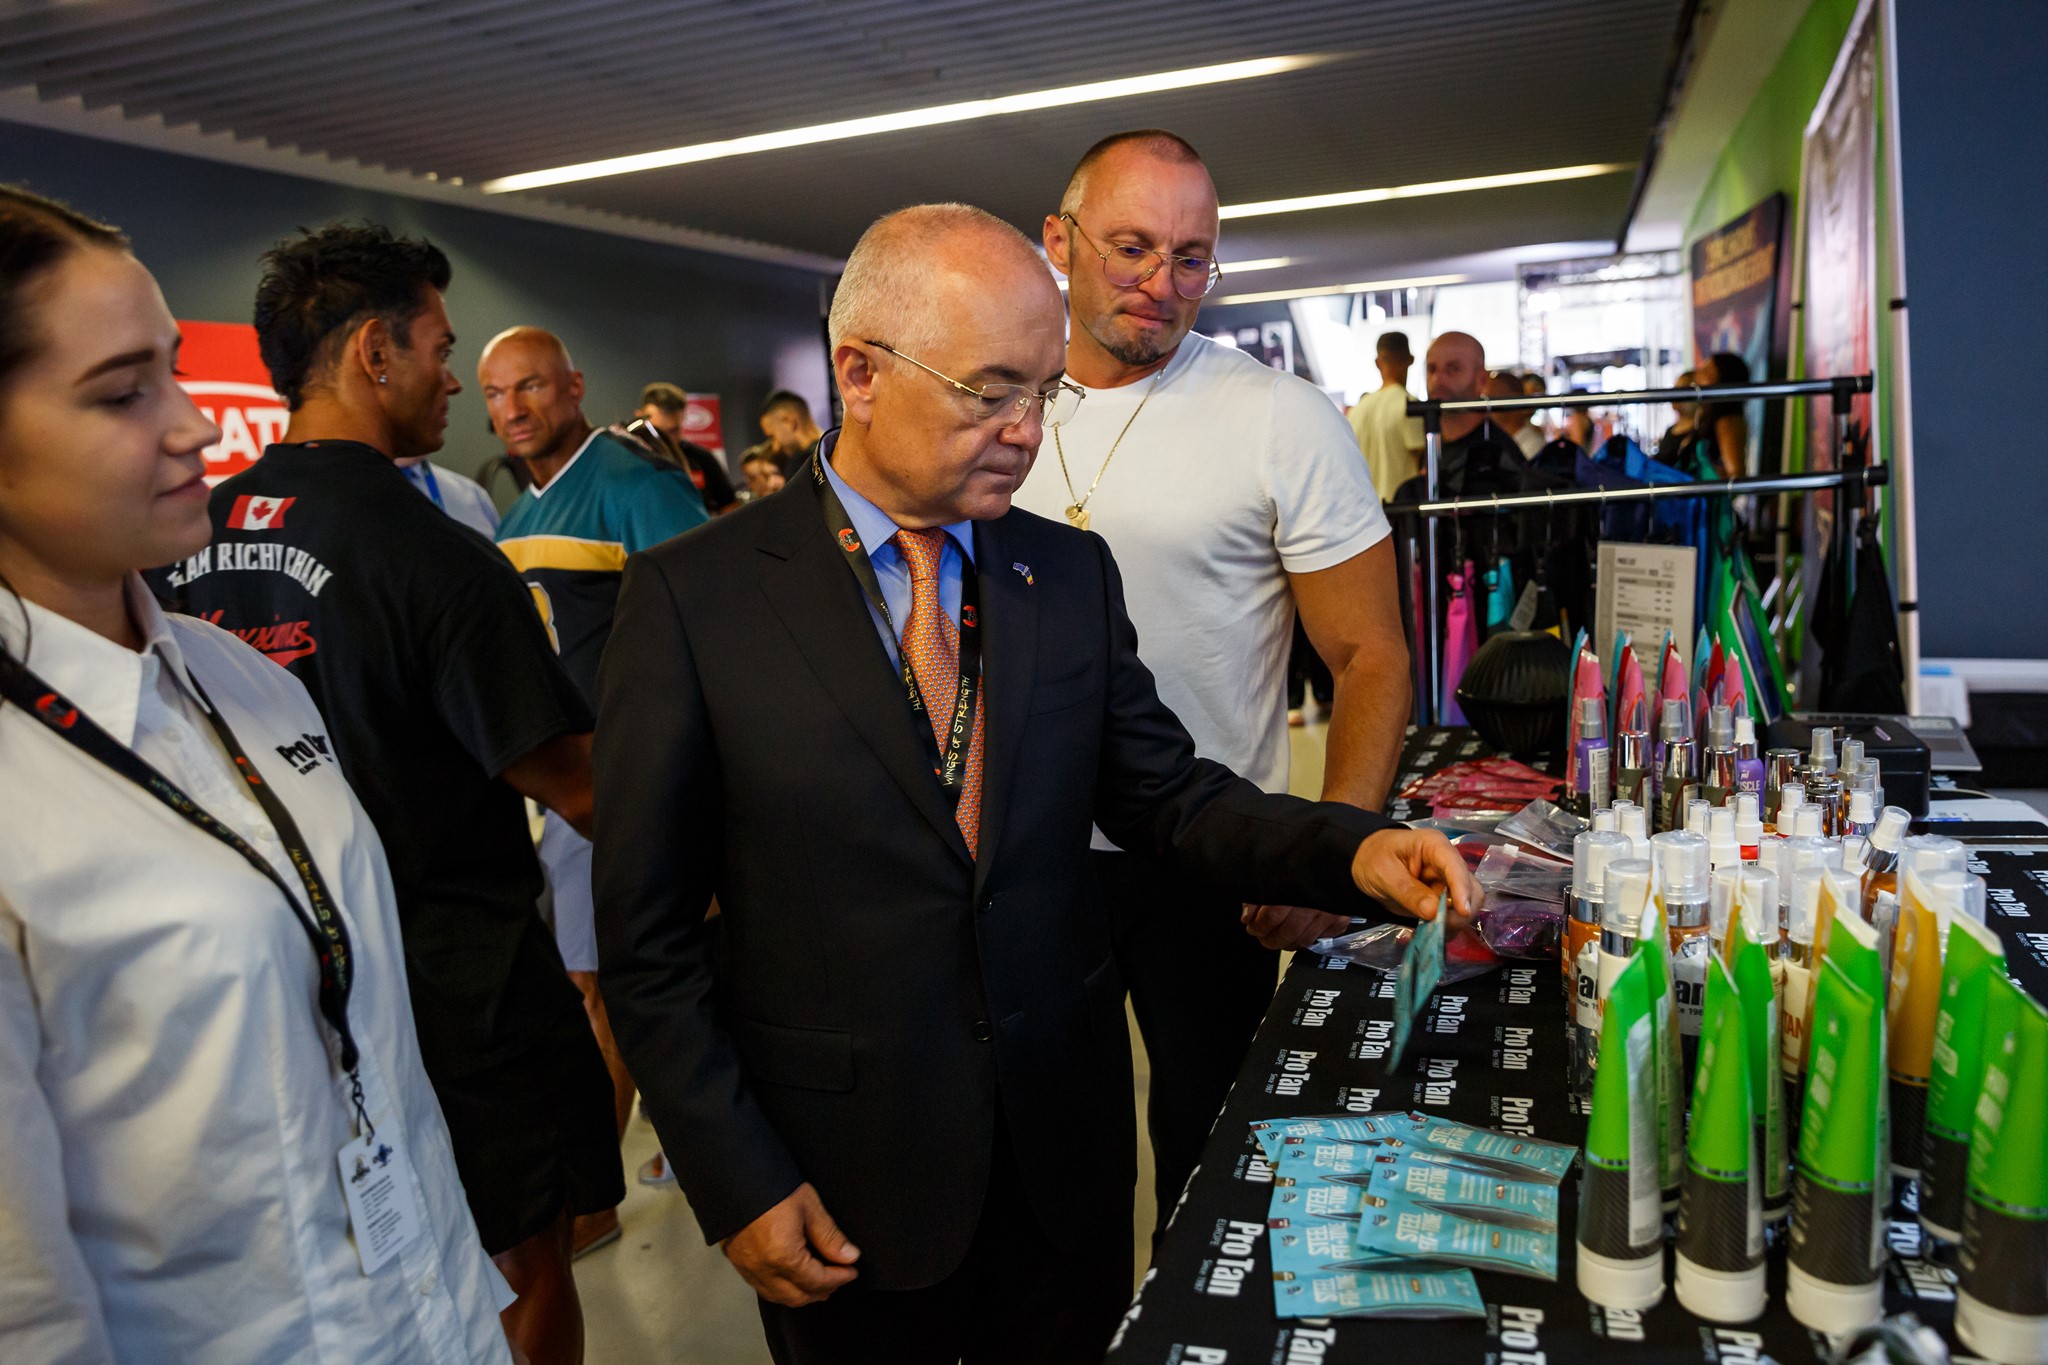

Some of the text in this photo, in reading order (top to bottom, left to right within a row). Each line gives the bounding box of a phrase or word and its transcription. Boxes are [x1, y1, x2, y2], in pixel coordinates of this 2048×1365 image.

[942, 675, 974, 786] WINGS OF STRENGTH
[275, 740, 316, 768] Pro
[1987, 888, 2017, 903] Pro
[1999, 902, 2031, 918] Tan
[1508, 969, 1537, 1004] Pro Tan
[1675, 980, 1705, 1005] an
[1301, 989, 1341, 1027] Pro Tan
[1435, 995, 1469, 1034] Pro Tan
[1358, 1020, 1395, 1059] Pro Tan
[1502, 1026, 1533, 1070] Pro Tan
[1275, 1050, 1318, 1096] Pro Tan
[1424, 1058, 1459, 1105] Pro Tan
[1346, 1087, 1380, 1112] Pro
[1490, 1095, 1500, 1117] EUROPE
[1501, 1097, 1534, 1123] Pro
[1314, 1145, 1337, 1168] STEEL
[1406, 1167, 1430, 1194] STEEL
[1305, 1186, 1329, 1214] STEEL
[1209, 1218, 1227, 1247] EUROPE
[1306, 1226, 1330, 1256] STEEL
[1395, 1212, 1422, 1243] STEEL
[1207, 1220, 1265, 1296] Pro Tan
[1501, 1305, 1544, 1349] Pro
[1605, 1308, 1645, 1340] an
